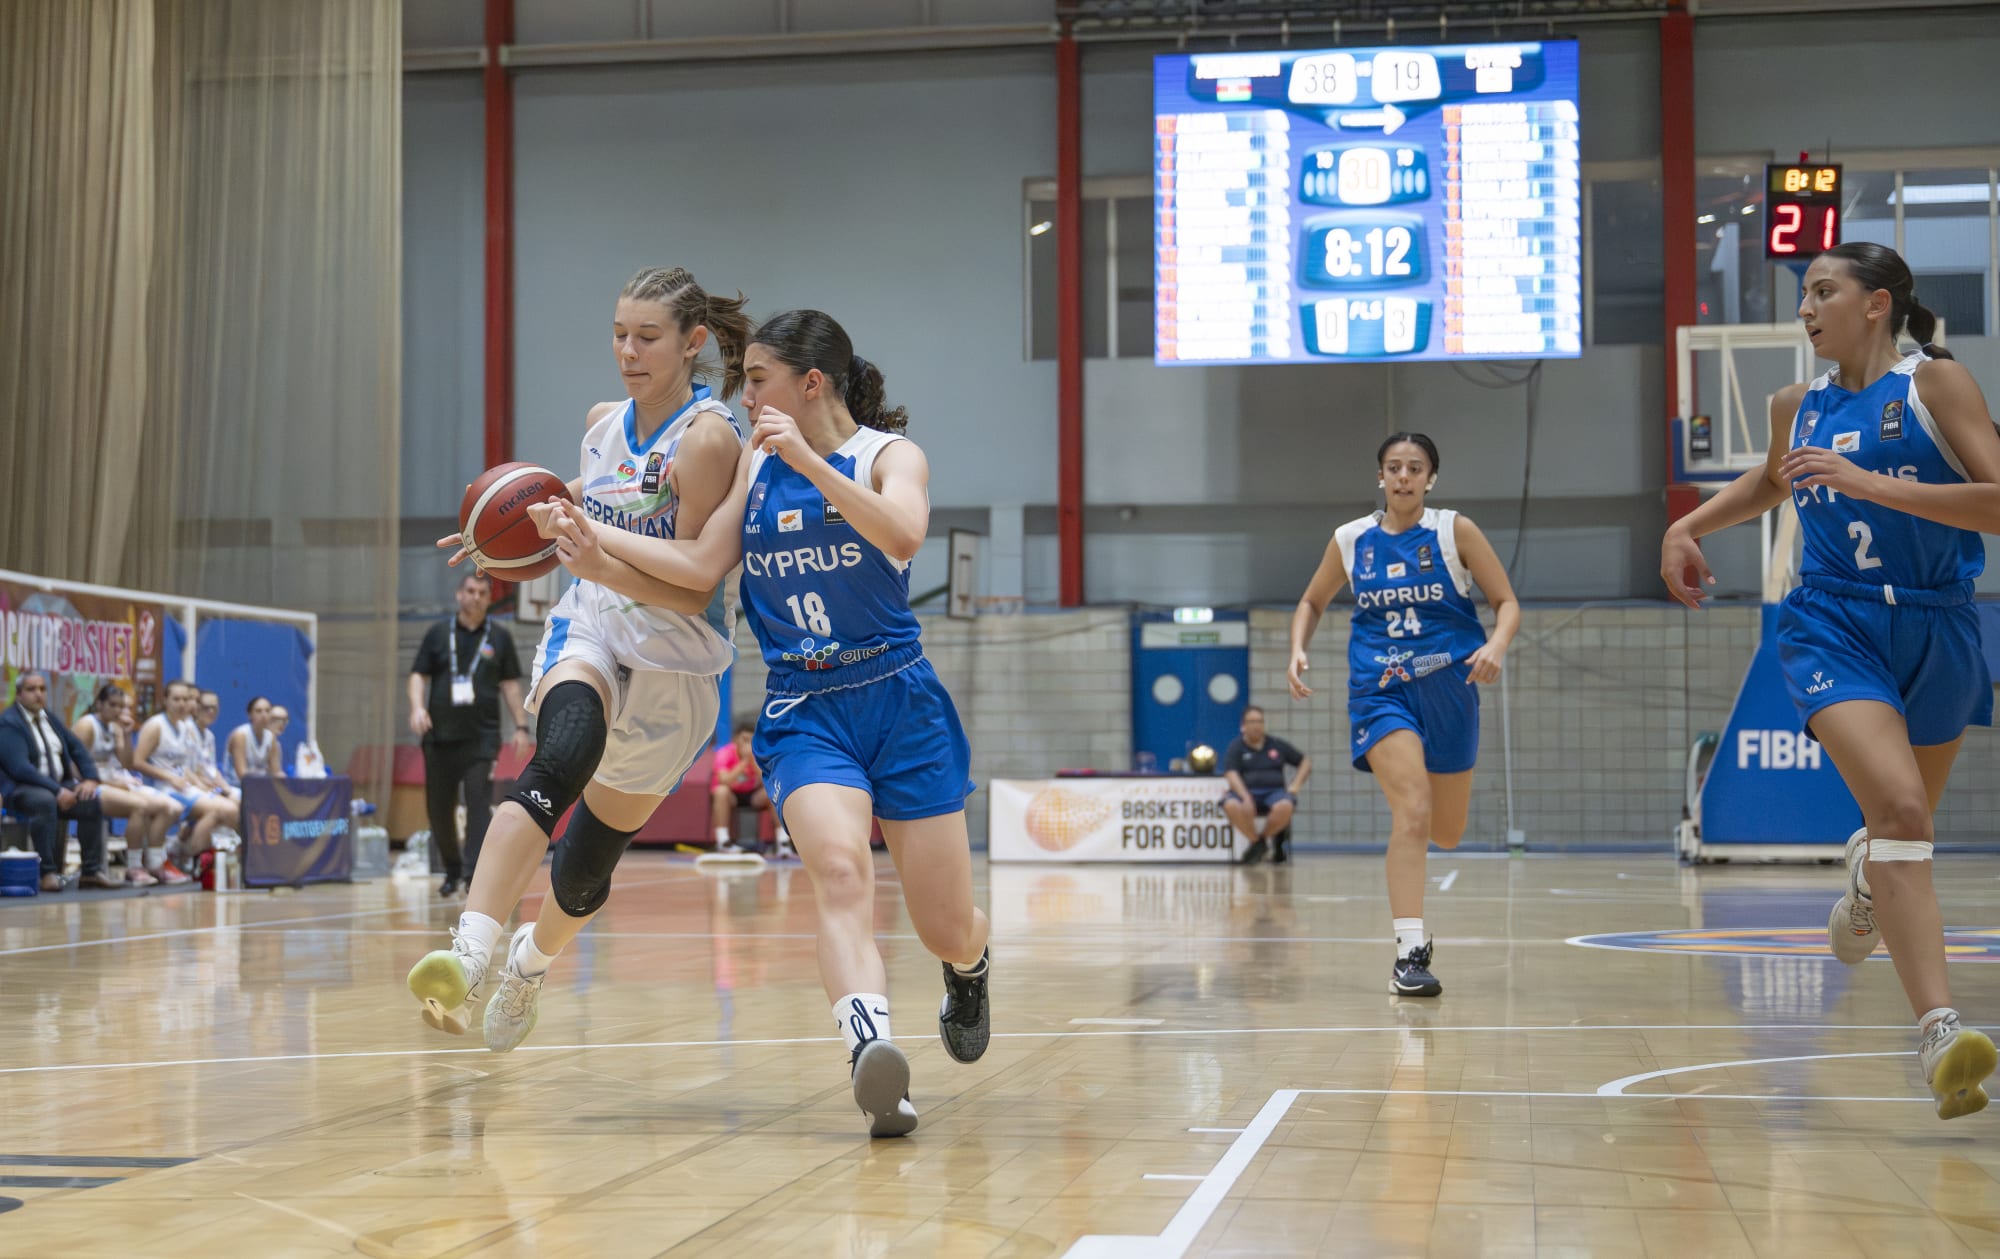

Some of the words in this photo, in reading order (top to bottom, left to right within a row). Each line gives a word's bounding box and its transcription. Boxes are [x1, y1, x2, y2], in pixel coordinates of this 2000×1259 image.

[1304, 63, 1336, 94] 38
[1394, 60, 1420, 91] 19
[1784, 168, 1836, 192] 8:12
[1771, 204, 1834, 252] 21
[1325, 227, 1411, 277] 8:12
[498, 481, 545, 516] molten
[746, 542, 863, 578] CYPRUS
[1847, 521, 1883, 571] 2
[1358, 583, 1444, 609] CYPRUS
[786, 591, 832, 638] 18
[1385, 606, 1422, 638] 24
[1738, 730, 1821, 769] FIBA
[1122, 800, 1225, 819] BASKETBAL
[1122, 825, 1165, 849] FOR
[1173, 824, 1233, 849] GOOD
